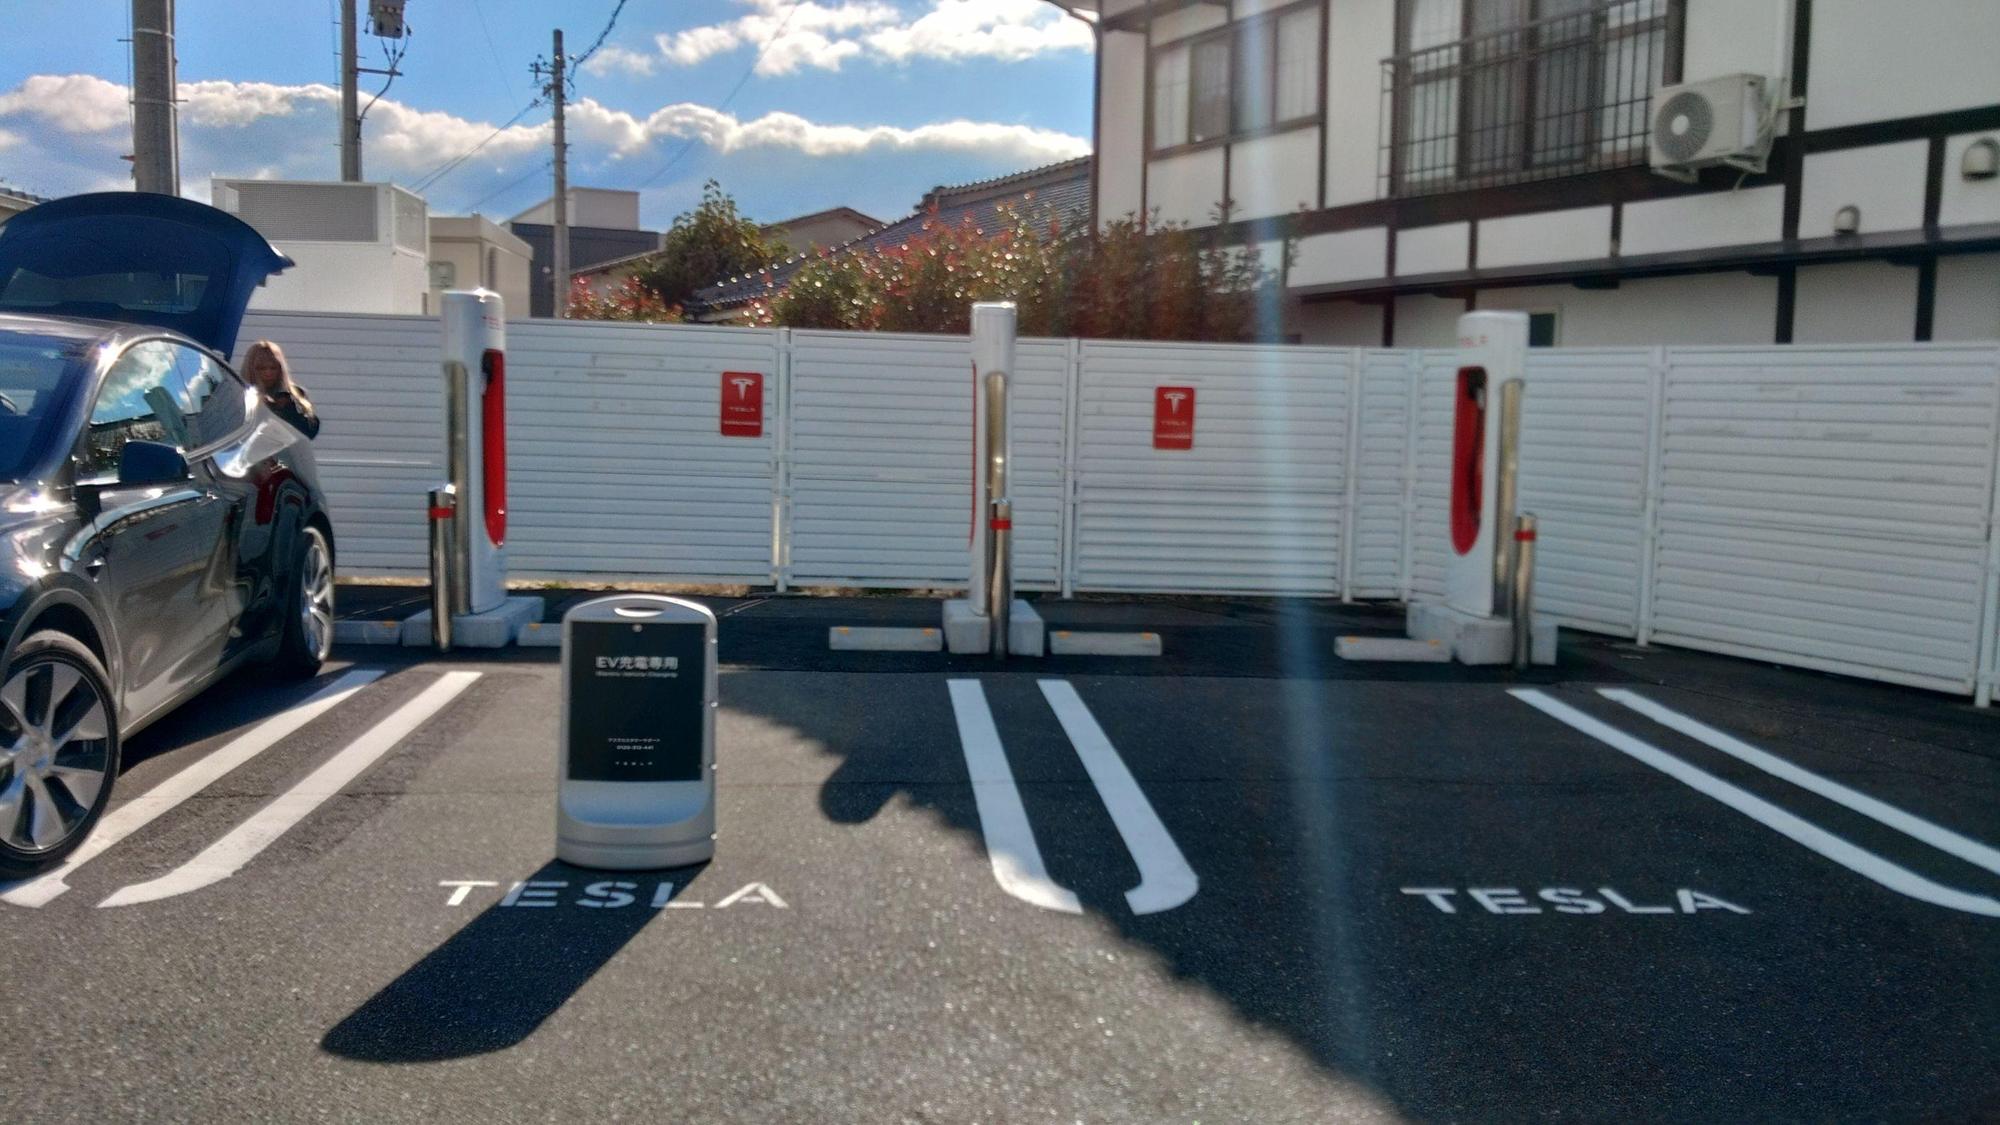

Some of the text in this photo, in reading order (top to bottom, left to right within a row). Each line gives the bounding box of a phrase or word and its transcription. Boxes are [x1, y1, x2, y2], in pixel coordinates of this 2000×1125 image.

[595, 656, 678, 670] EV充電専用
[438, 881, 789, 909] TESLA
[1400, 888, 1752, 914] TESLA
